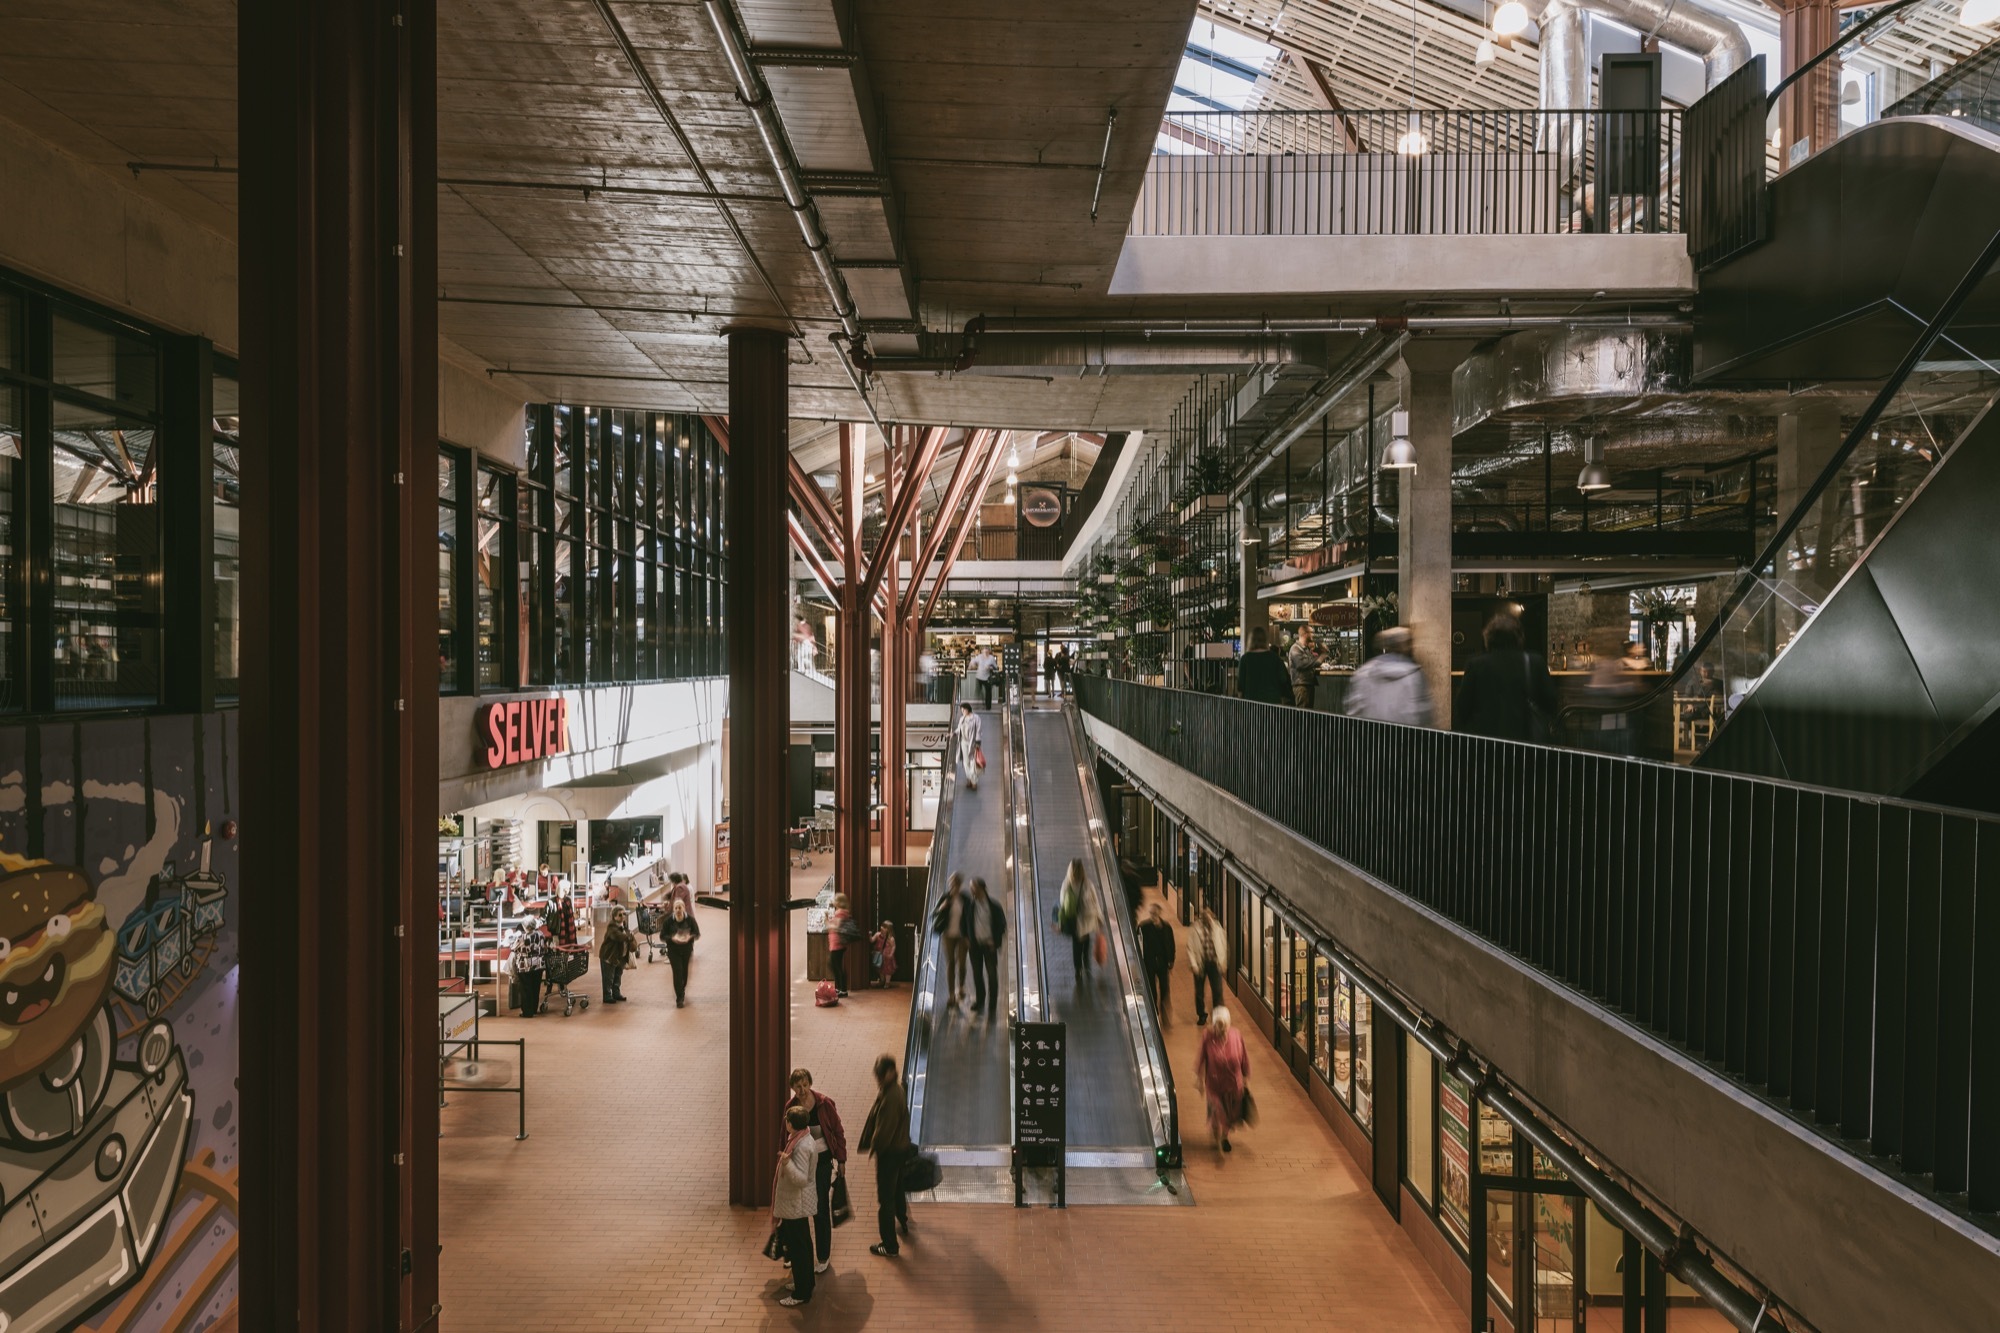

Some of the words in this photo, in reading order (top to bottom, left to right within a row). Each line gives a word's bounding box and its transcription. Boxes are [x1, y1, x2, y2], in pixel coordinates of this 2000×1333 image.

[487, 698, 570, 769] SELVER
[1020, 1028, 1026, 1036] 2
[1020, 1070, 1025, 1078] 1
[1020, 1109, 1029, 1117] -1
